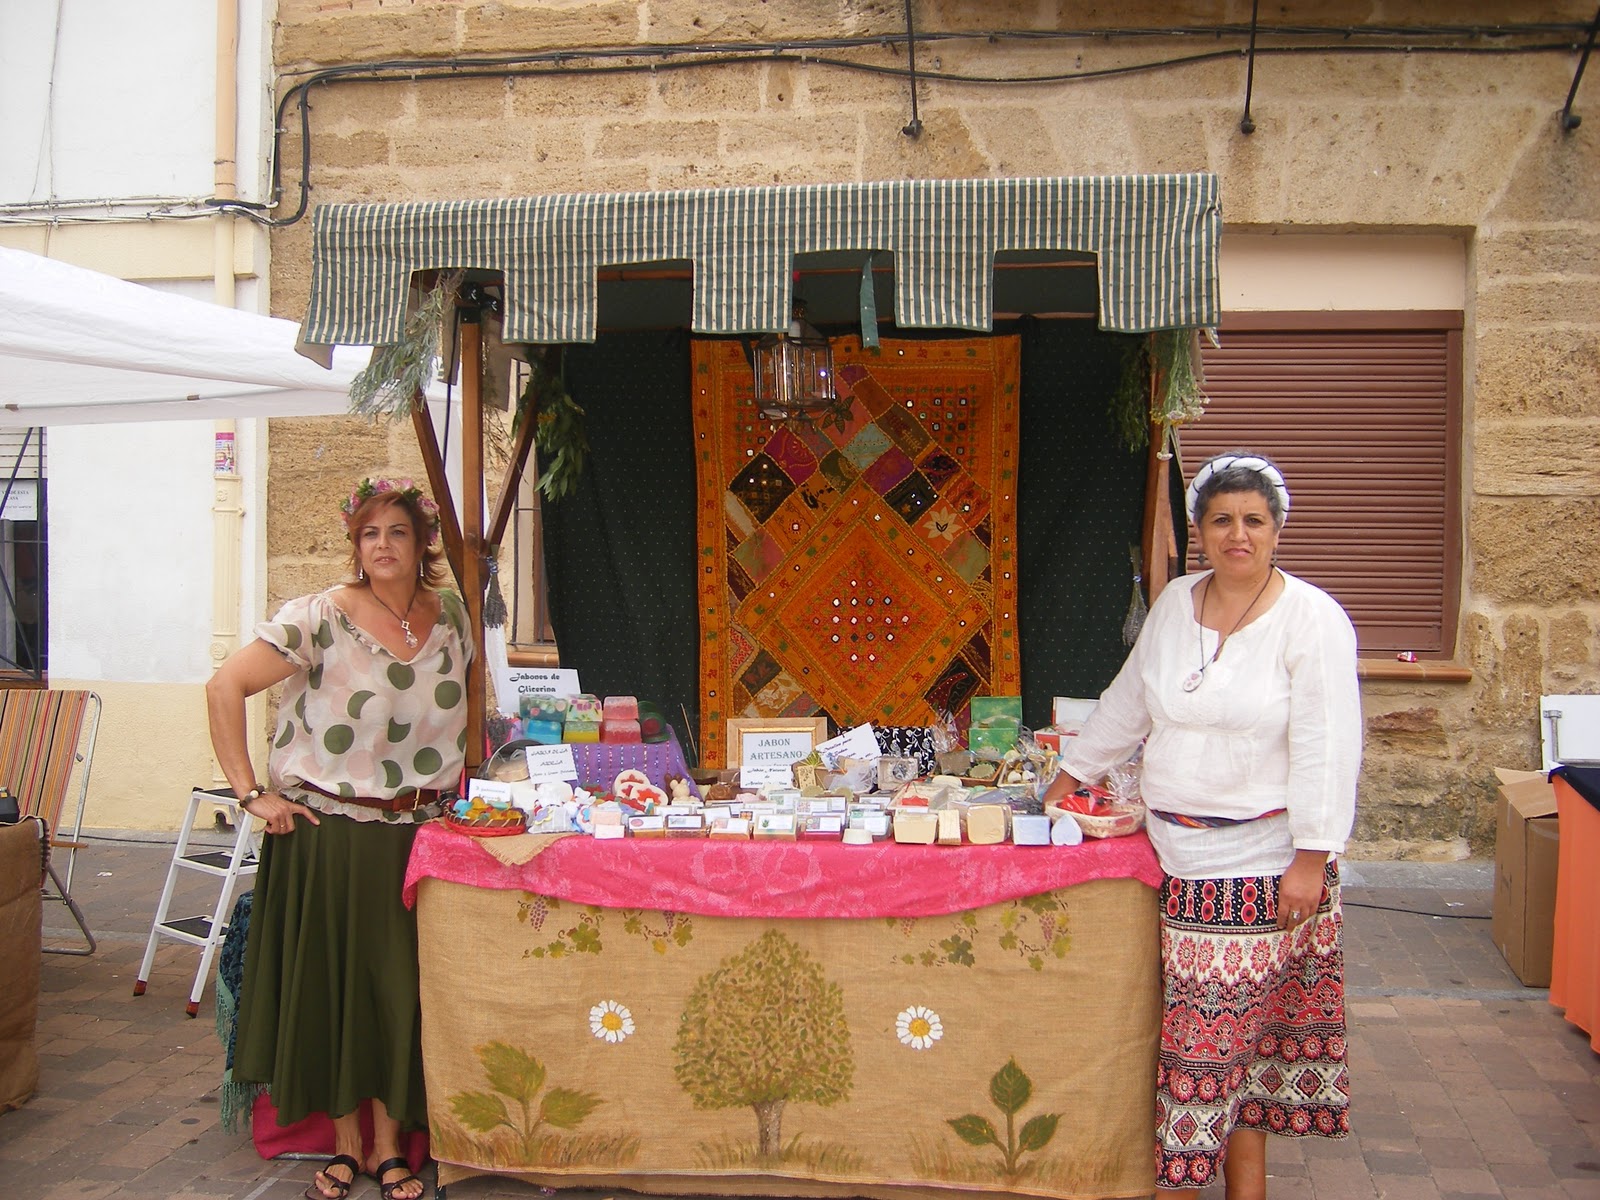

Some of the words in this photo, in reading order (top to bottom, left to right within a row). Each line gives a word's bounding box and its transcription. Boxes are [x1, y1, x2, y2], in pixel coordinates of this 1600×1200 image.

[509, 673, 548, 682] Jabones
[518, 685, 556, 694] Glicerina
[758, 738, 791, 747] JABON
[750, 750, 803, 761] ARTESANO
